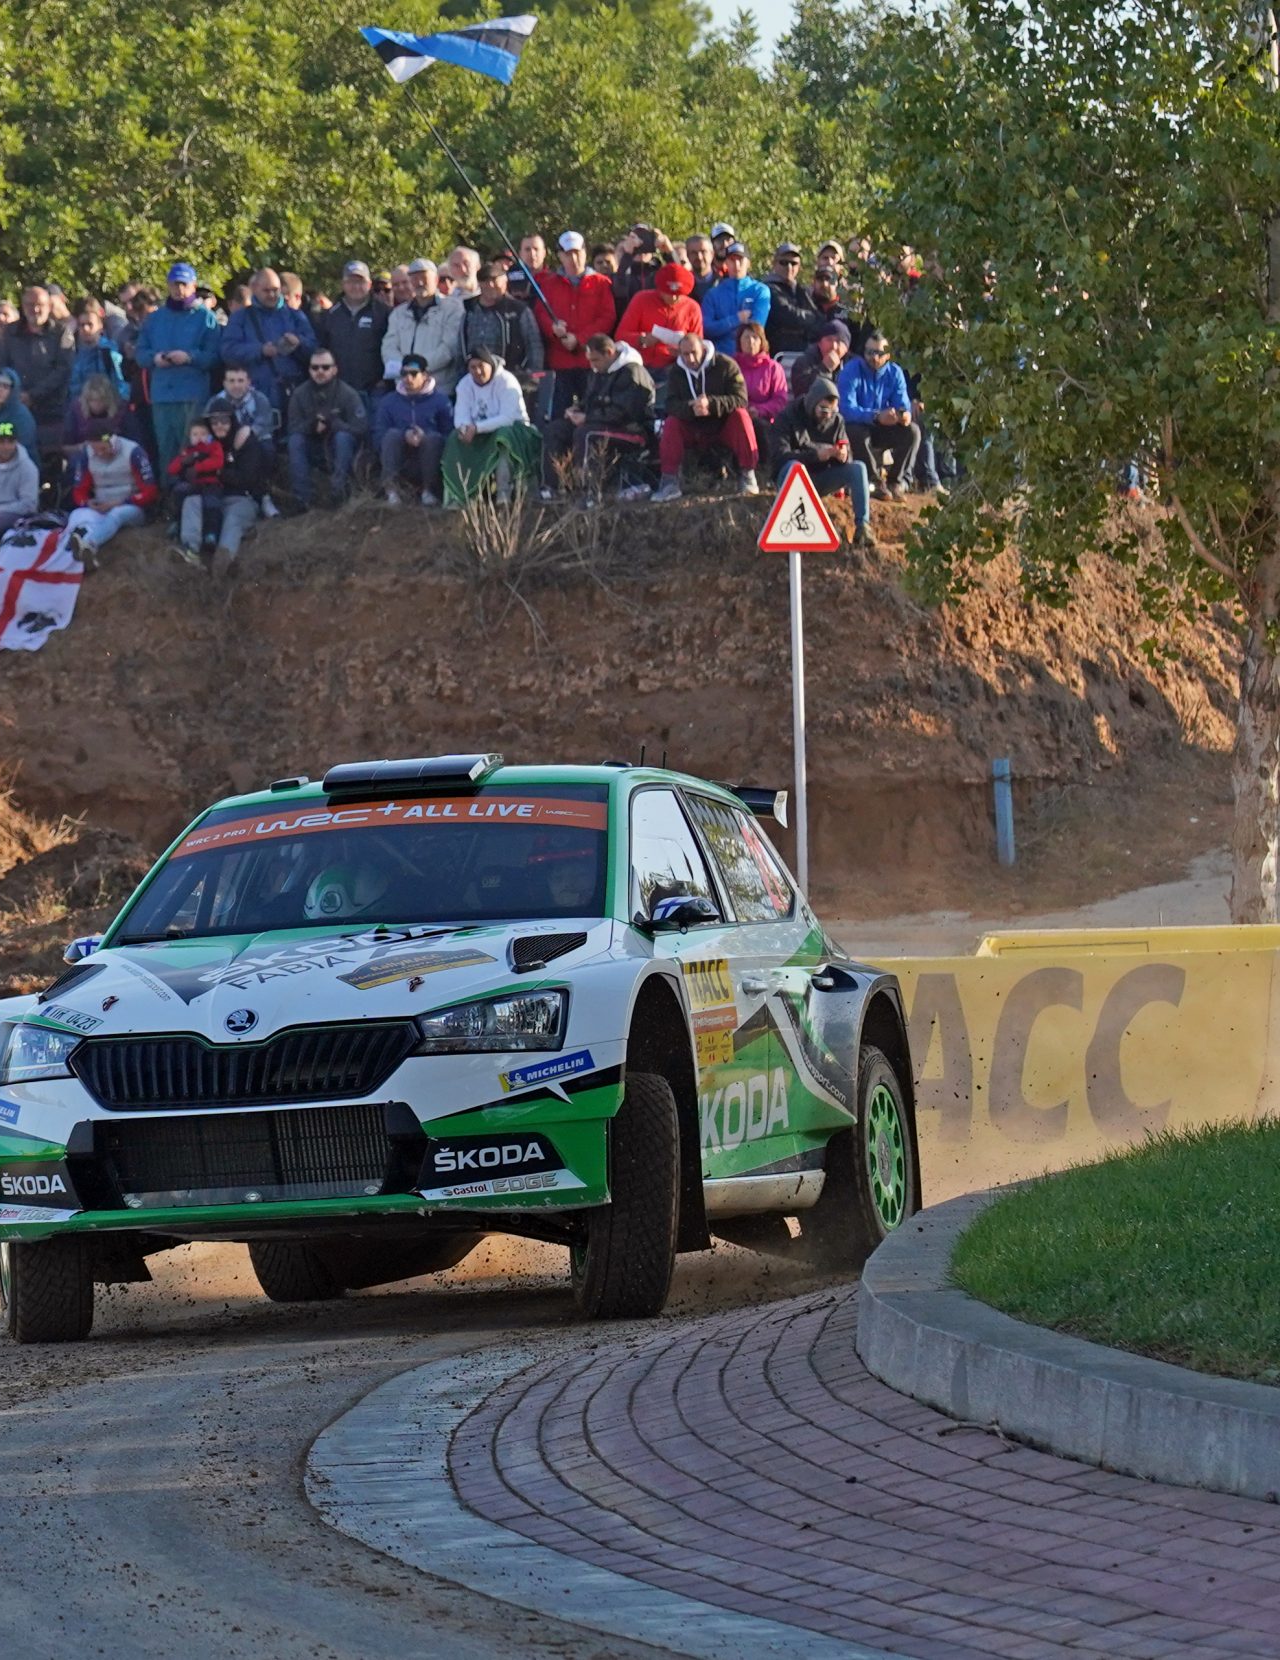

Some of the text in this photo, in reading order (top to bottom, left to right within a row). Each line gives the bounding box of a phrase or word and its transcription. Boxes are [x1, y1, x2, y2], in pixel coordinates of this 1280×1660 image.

[403, 803, 458, 818] ALL
[468, 803, 536, 817] LIVE
[223, 828, 247, 840] PRO
[512, 925, 556, 934] evo
[227, 955, 357, 991] FABIA
[687, 958, 730, 1004] RACC
[66, 1013, 97, 1030] 0423
[909, 963, 1186, 1146] ACC
[526, 1057, 585, 1081] MICHELIN
[699, 1066, 790, 1159] KODA
[434, 1142, 545, 1172] ŠKODA
[0, 1172, 67, 1196] ŠKODA
[453, 1172, 559, 1196] Castrol EDGE
